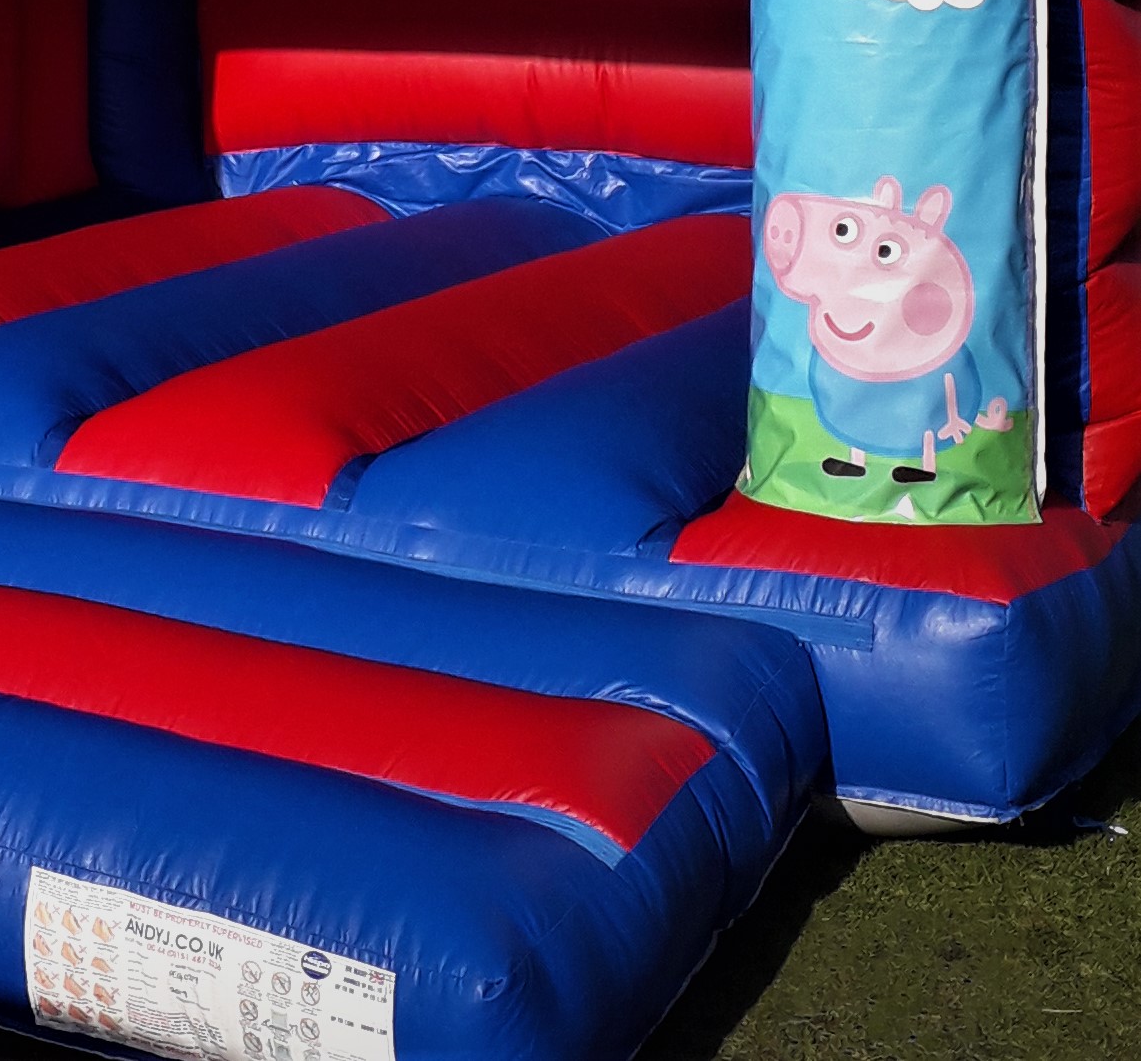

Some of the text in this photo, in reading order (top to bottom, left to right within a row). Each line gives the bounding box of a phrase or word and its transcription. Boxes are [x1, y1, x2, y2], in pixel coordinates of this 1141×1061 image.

[129, 901, 150, 915] MUST
[153, 908, 163, 919] BE
[125, 918, 225, 961] ANDYJ.CO.UK
